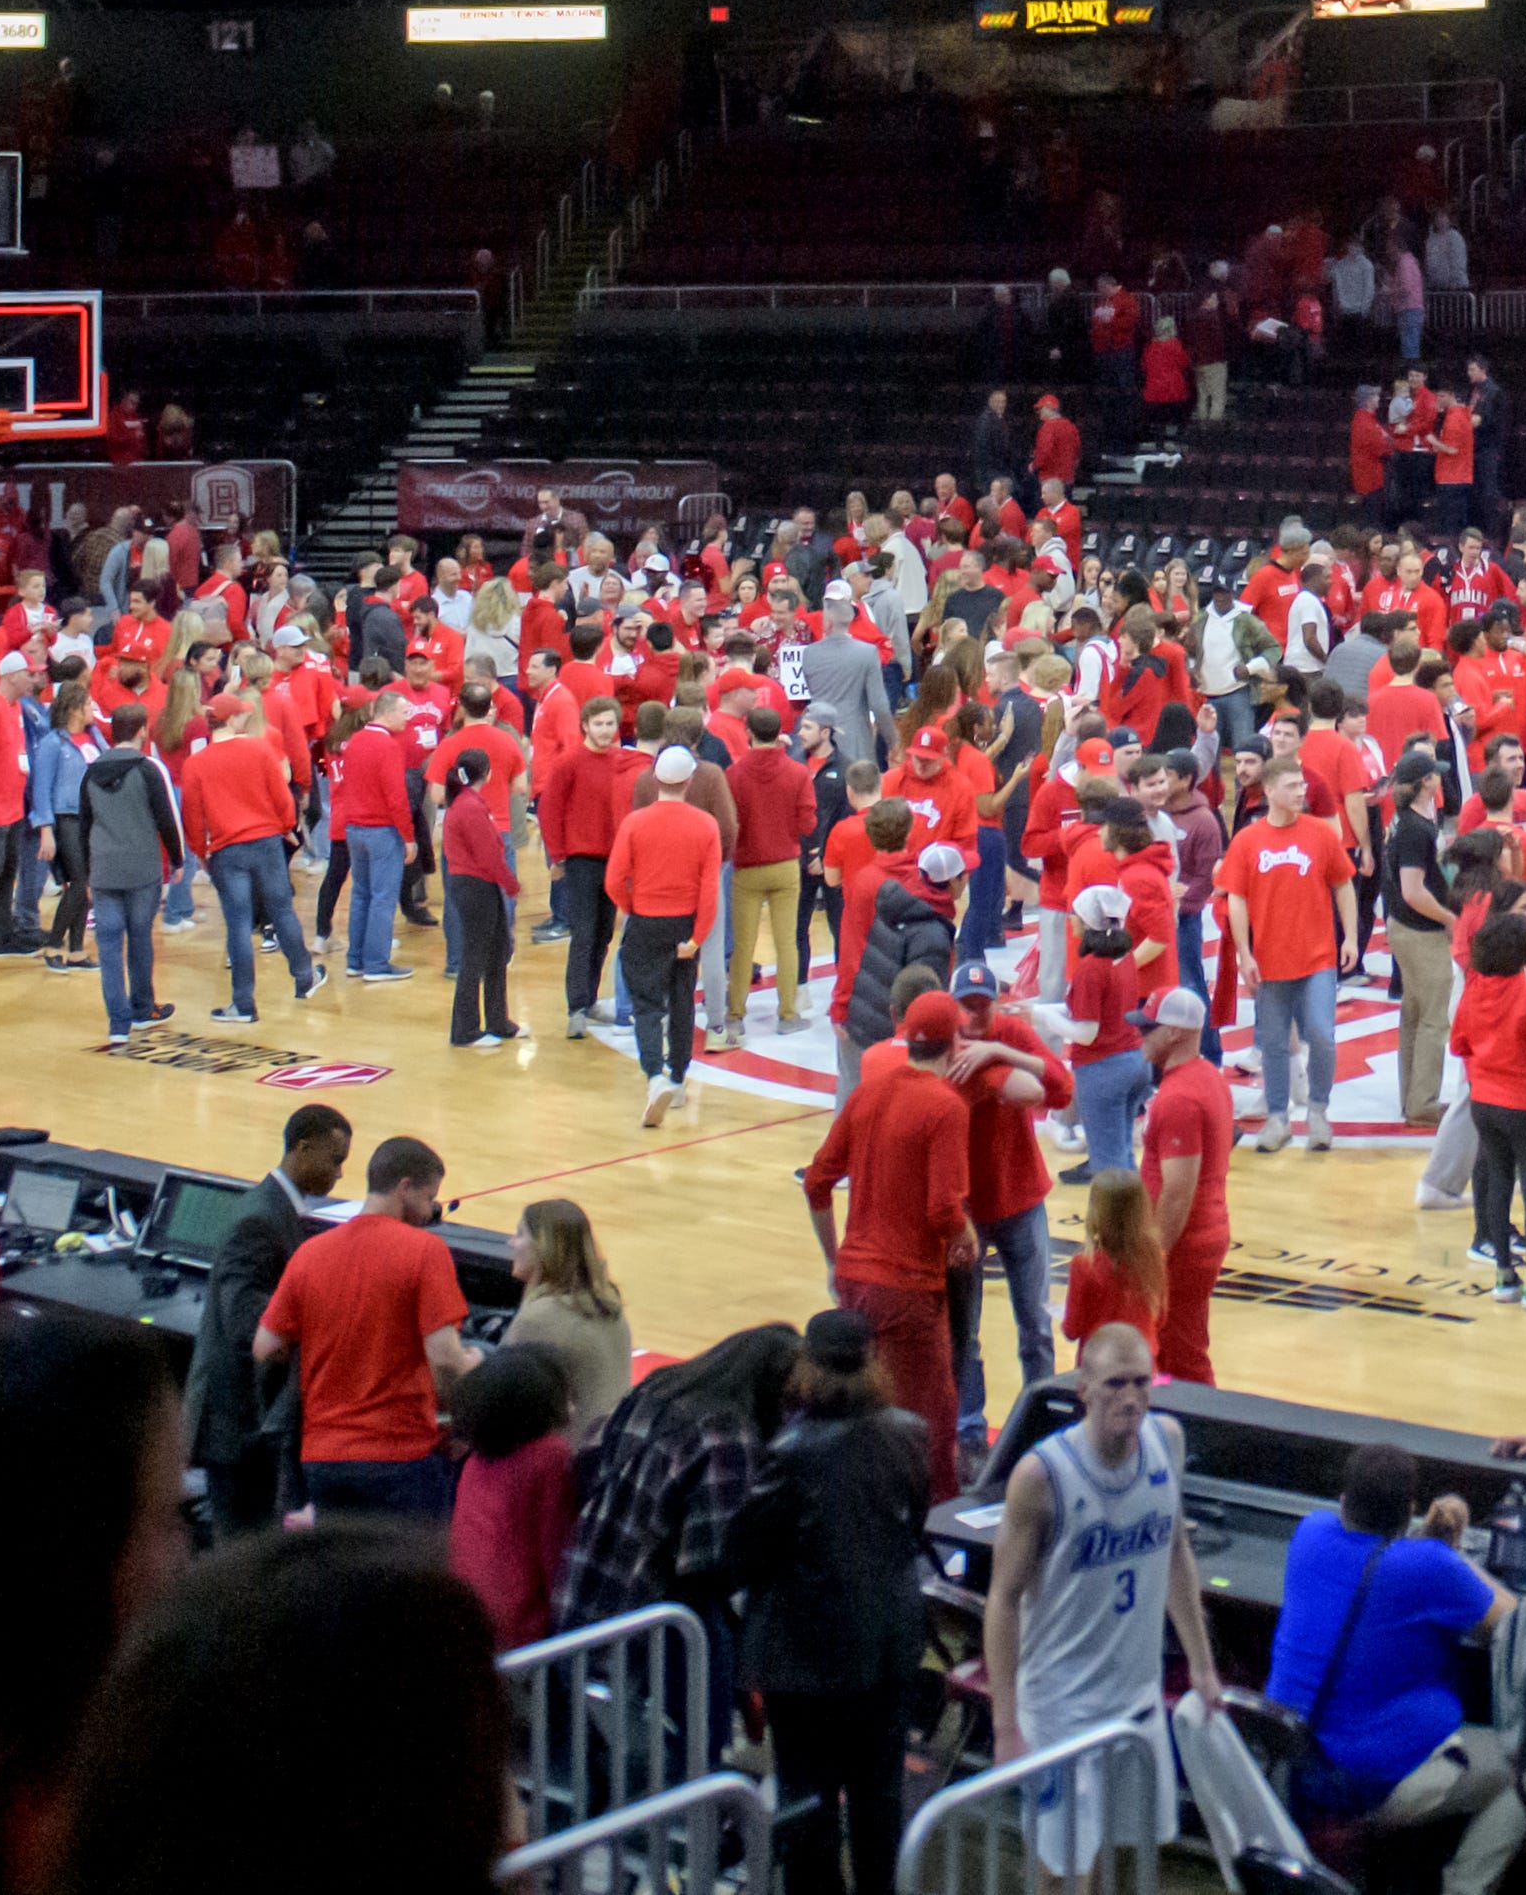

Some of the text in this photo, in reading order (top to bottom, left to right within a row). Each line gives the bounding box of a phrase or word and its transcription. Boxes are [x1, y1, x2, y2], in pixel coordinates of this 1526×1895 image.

[556, 8, 603, 19] MACHINE
[1, 23, 39, 39] 3680
[1257, 844, 1312, 877] Bradley
[1072, 1508, 1170, 1572] Drake
[1114, 1569, 1136, 1615] 3
